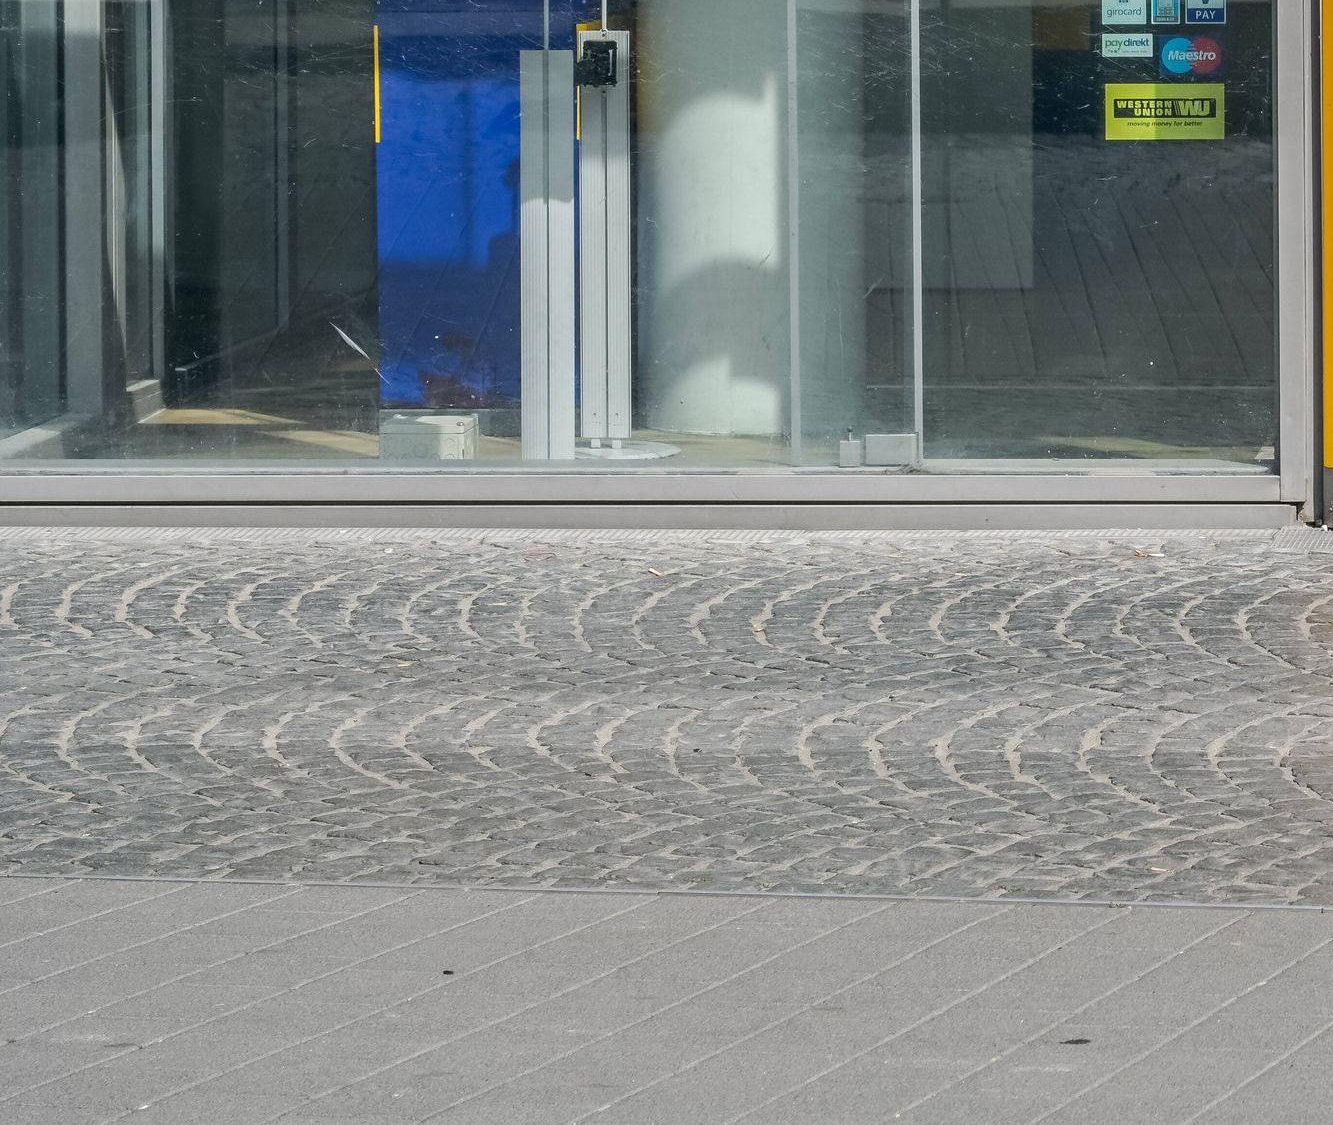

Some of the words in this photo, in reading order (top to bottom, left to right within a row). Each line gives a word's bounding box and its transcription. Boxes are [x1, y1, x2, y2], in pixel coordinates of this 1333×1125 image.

[1106, 7, 1142, 18] girocard
[1195, 10, 1216, 20] PAY
[1167, 50, 1216, 61] Maestro
[1117, 100, 1172, 108] WESTERN
[1178, 100, 1211, 117] WU
[1134, 108, 1172, 116] UNION
